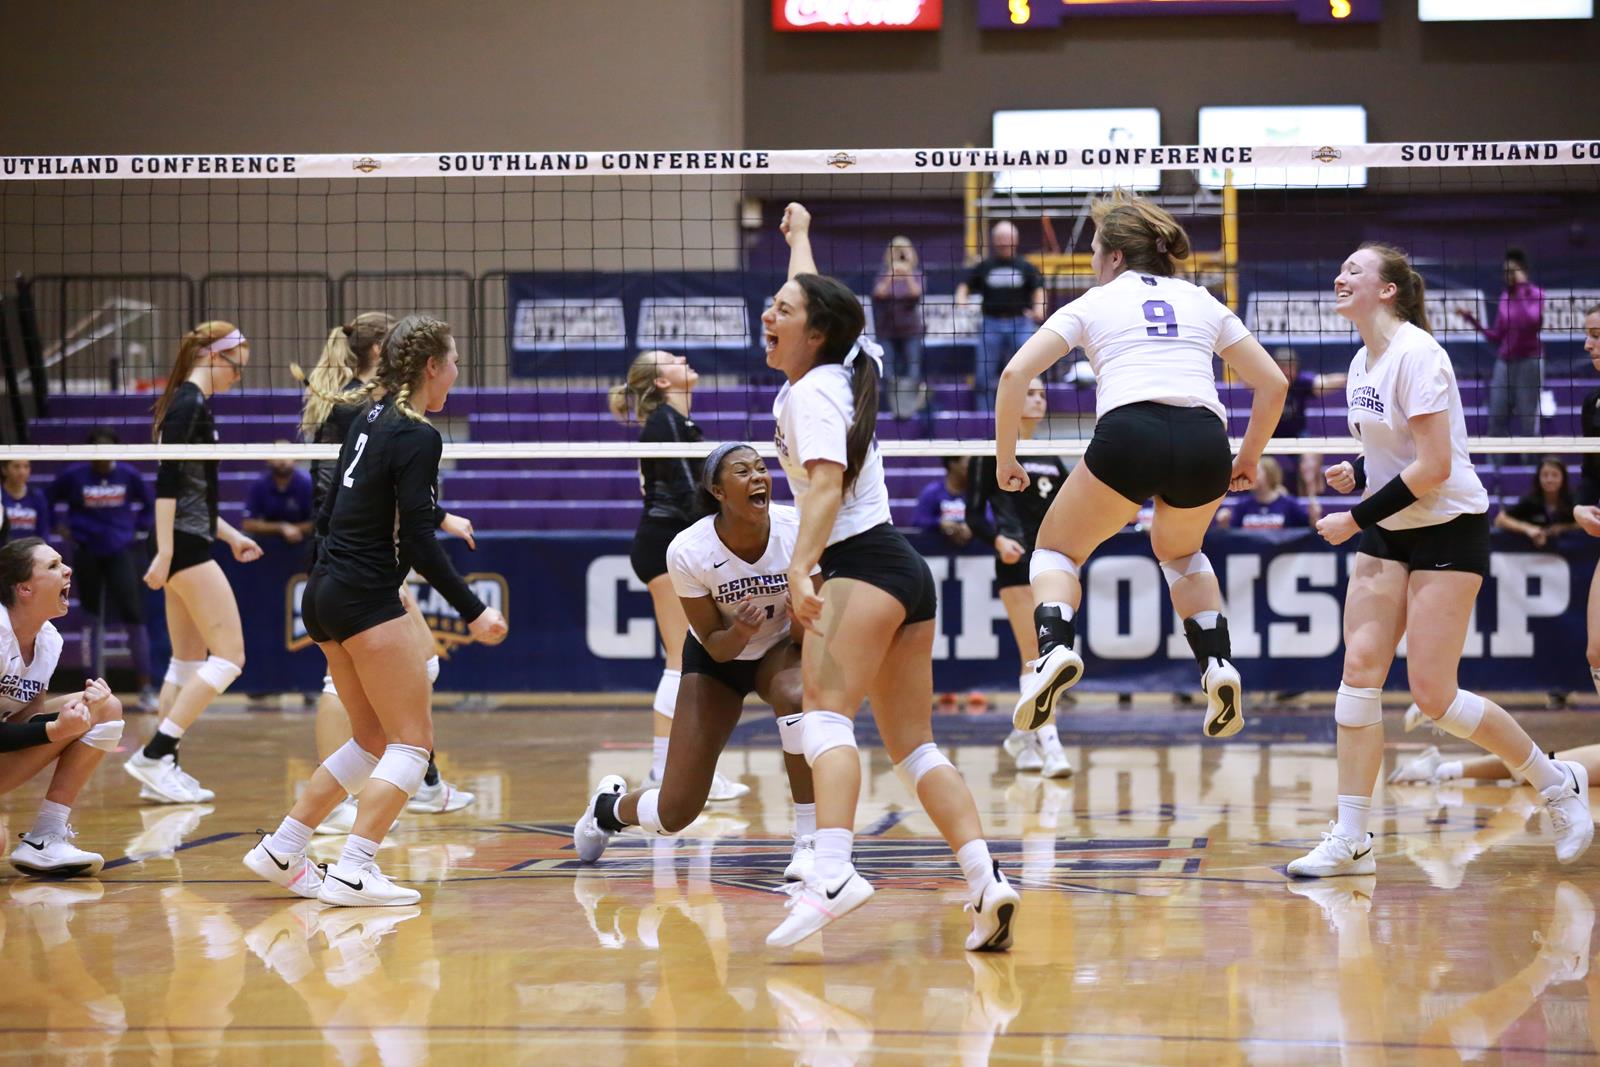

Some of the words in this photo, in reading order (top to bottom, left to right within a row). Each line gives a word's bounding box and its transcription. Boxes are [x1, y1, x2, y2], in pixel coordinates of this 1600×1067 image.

[915, 150, 1068, 167] SOUTHLAND
[1081, 147, 1252, 165] CONFERENCE
[1402, 144, 1558, 161] SOUTHLAND
[1572, 143, 1600, 159] CO
[3, 158, 119, 174] UTHLAND
[131, 157, 296, 174] CONFERENCE
[438, 154, 588, 171] SOUTHLAND
[601, 153, 769, 170] CONFERENCE
[1142, 300, 1178, 337] 9
[343, 432, 369, 488] 2
[764, 604, 775, 620] 1
